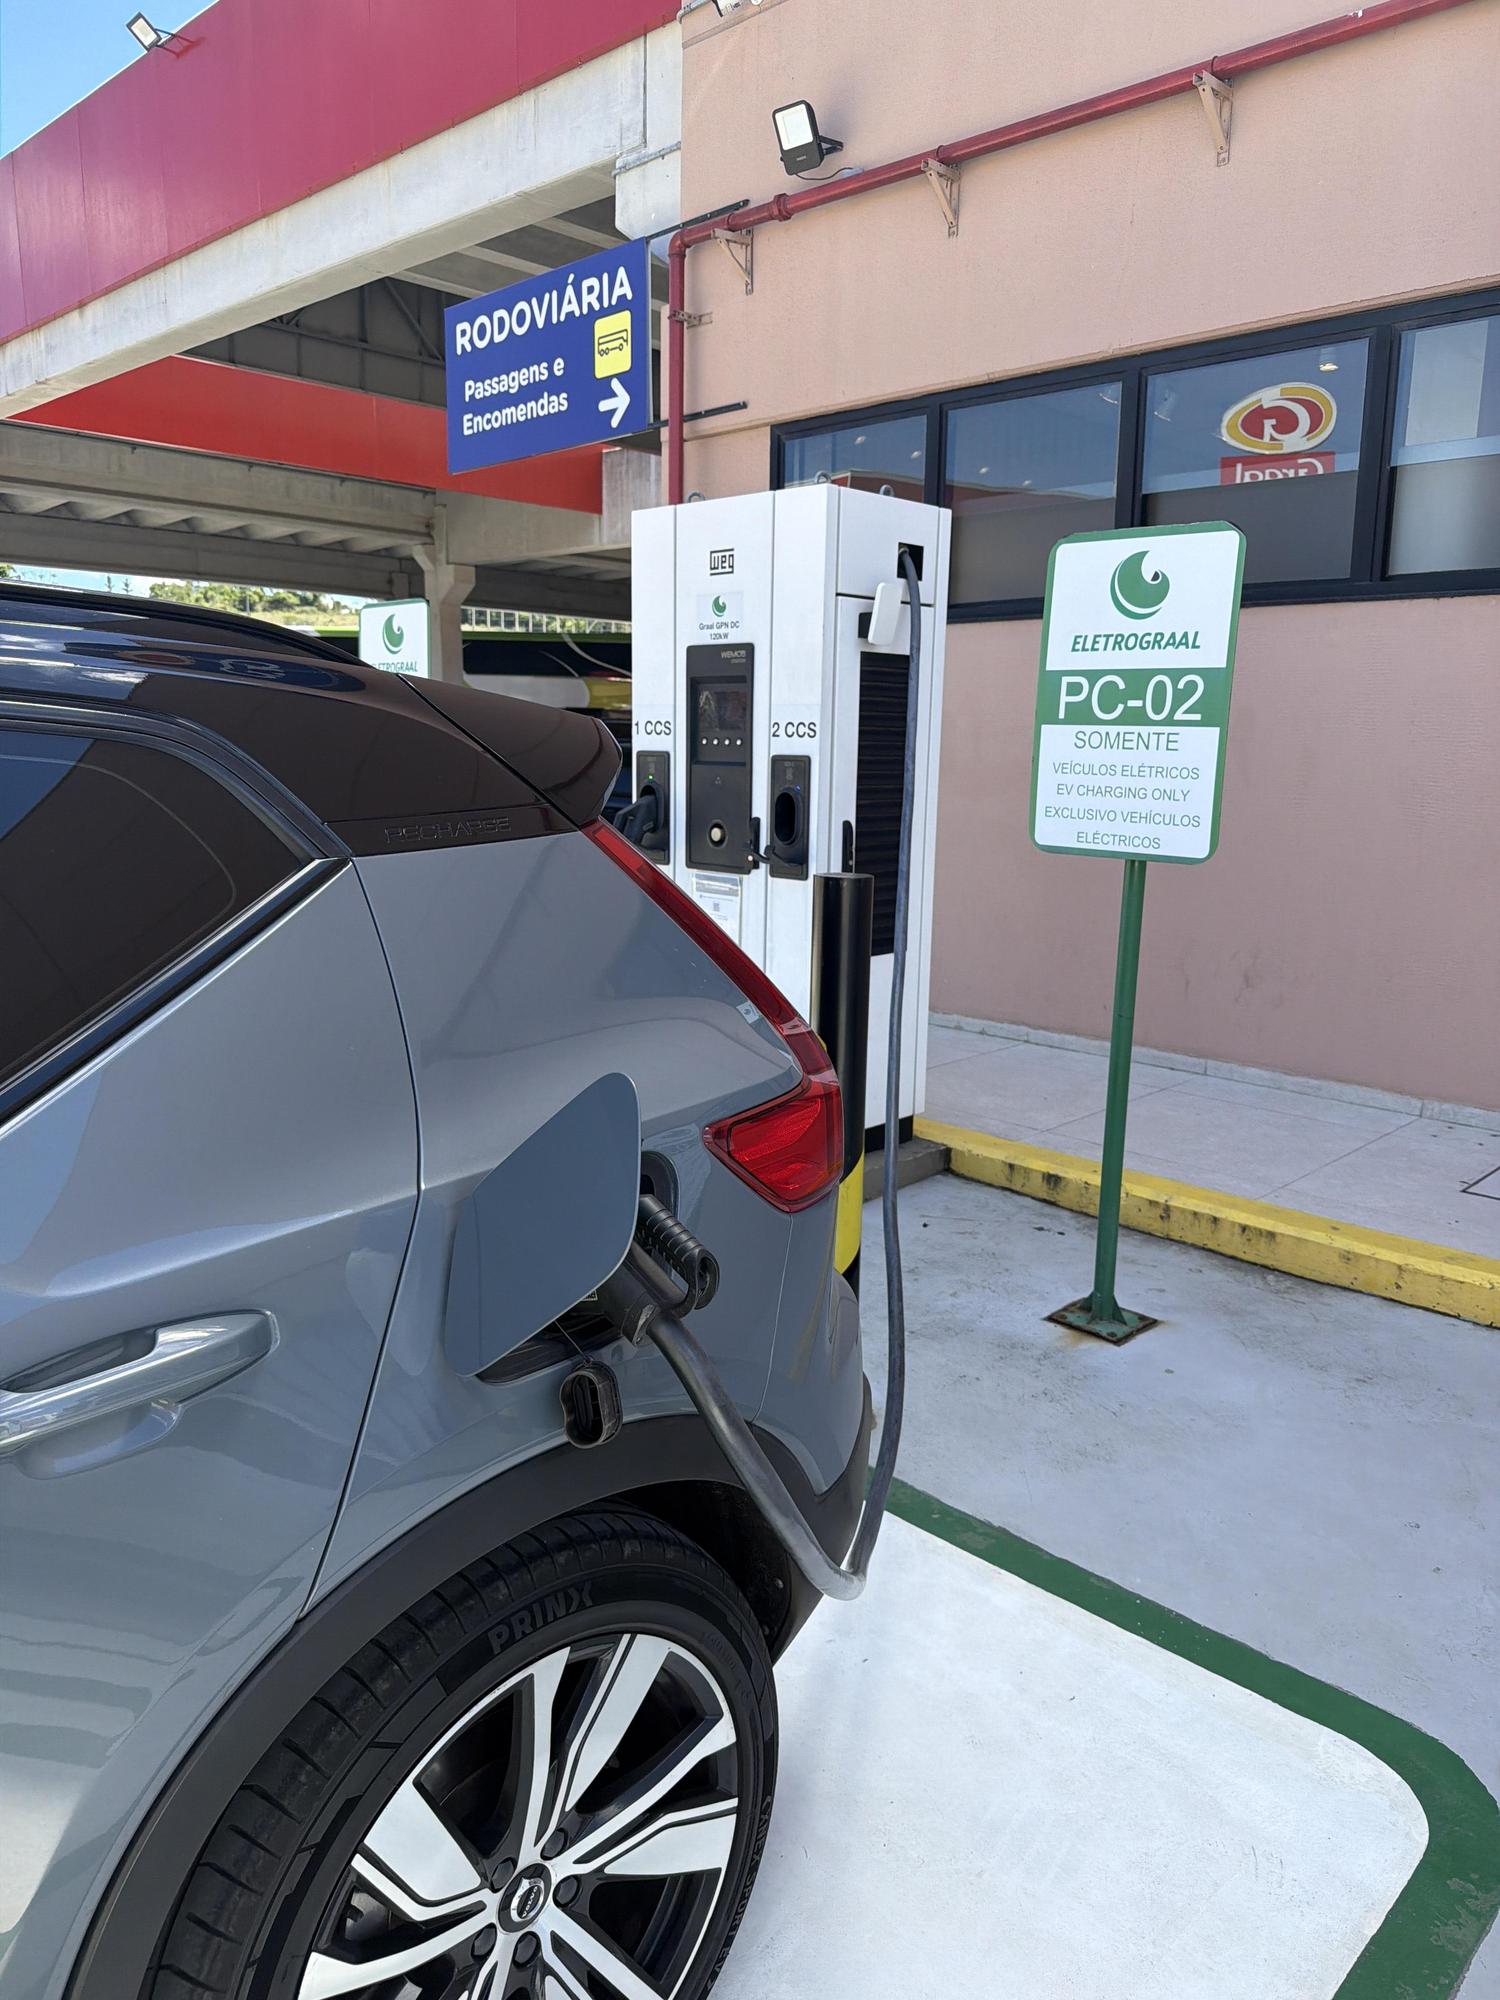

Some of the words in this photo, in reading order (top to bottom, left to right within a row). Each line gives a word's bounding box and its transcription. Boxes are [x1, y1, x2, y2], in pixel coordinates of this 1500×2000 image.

[455, 266, 633, 355] RODOVIÁRIA
[464, 361, 549, 402] Passagens
[553, 357, 564, 376] e
[463, 391, 568, 436] Encomendas
[730, 620, 740, 629] DC
[1070, 631, 1201, 653] ELETROGRAAL
[1058, 674, 1206, 721] PC-02
[634, 721, 641, 736] 1
[644, 720, 672, 736] CCS
[772, 722, 781, 738] 2
[784, 721, 817, 739] CCS
[1073, 730, 1181, 752] SOMENTE
[1052, 760, 1117, 778] VEÍCULOS
[1121, 762, 1200, 780] ELÉTRICOS
[1056, 783, 1074, 796] EV
[1076, 784, 1148, 800] CHARGING
[1151, 788, 1190, 802] ONLY
[1044, 806, 1118, 823] EXCLUSIVO
[1121, 808, 1201, 828] VEHÍCULOS
[384, 816, 512, 843] RECHARGE
[1076, 829, 1161, 849] ELÉCTRICOS
[487, 1580, 593, 1655] PRINX
